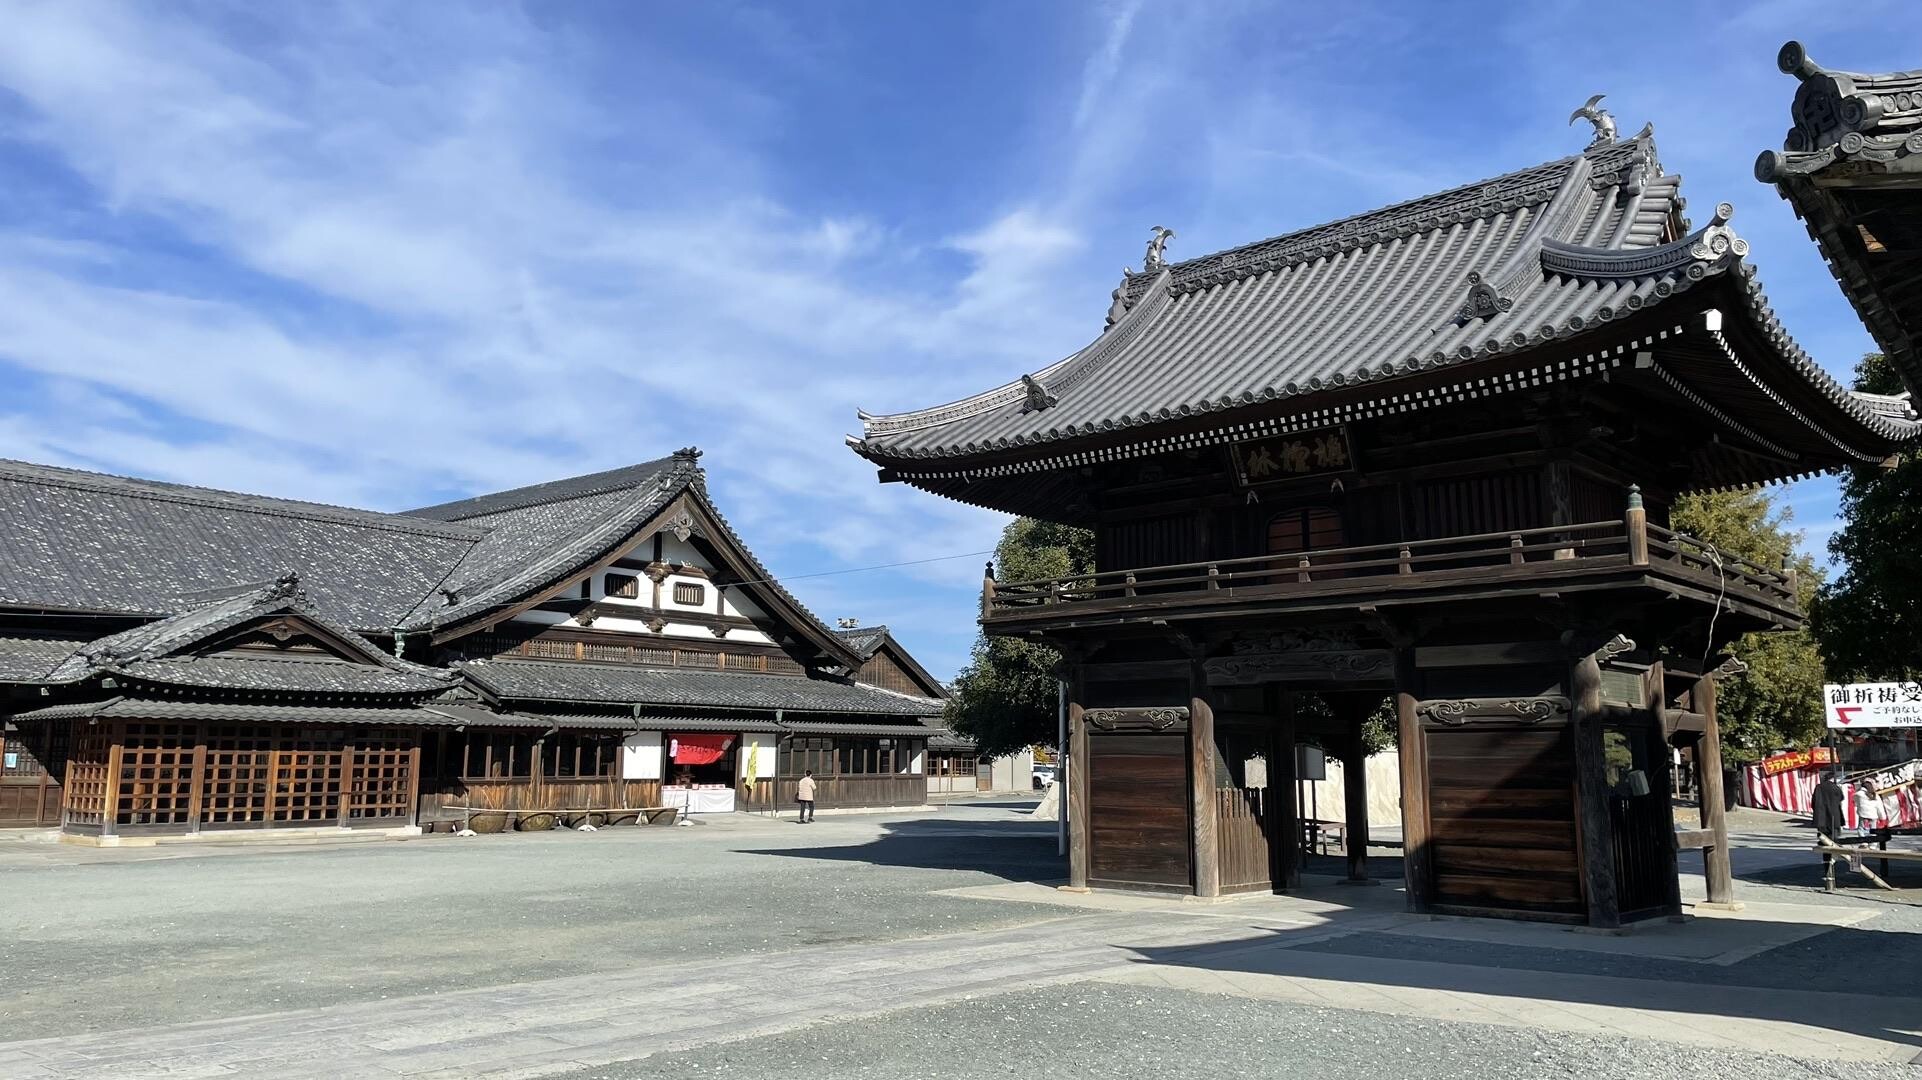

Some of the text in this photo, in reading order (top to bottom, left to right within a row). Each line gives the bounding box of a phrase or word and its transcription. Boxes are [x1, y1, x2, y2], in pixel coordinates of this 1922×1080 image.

[1831, 687, 1922, 704] 御祈祷受
[1873, 706, 1922, 714] ご予約なし
